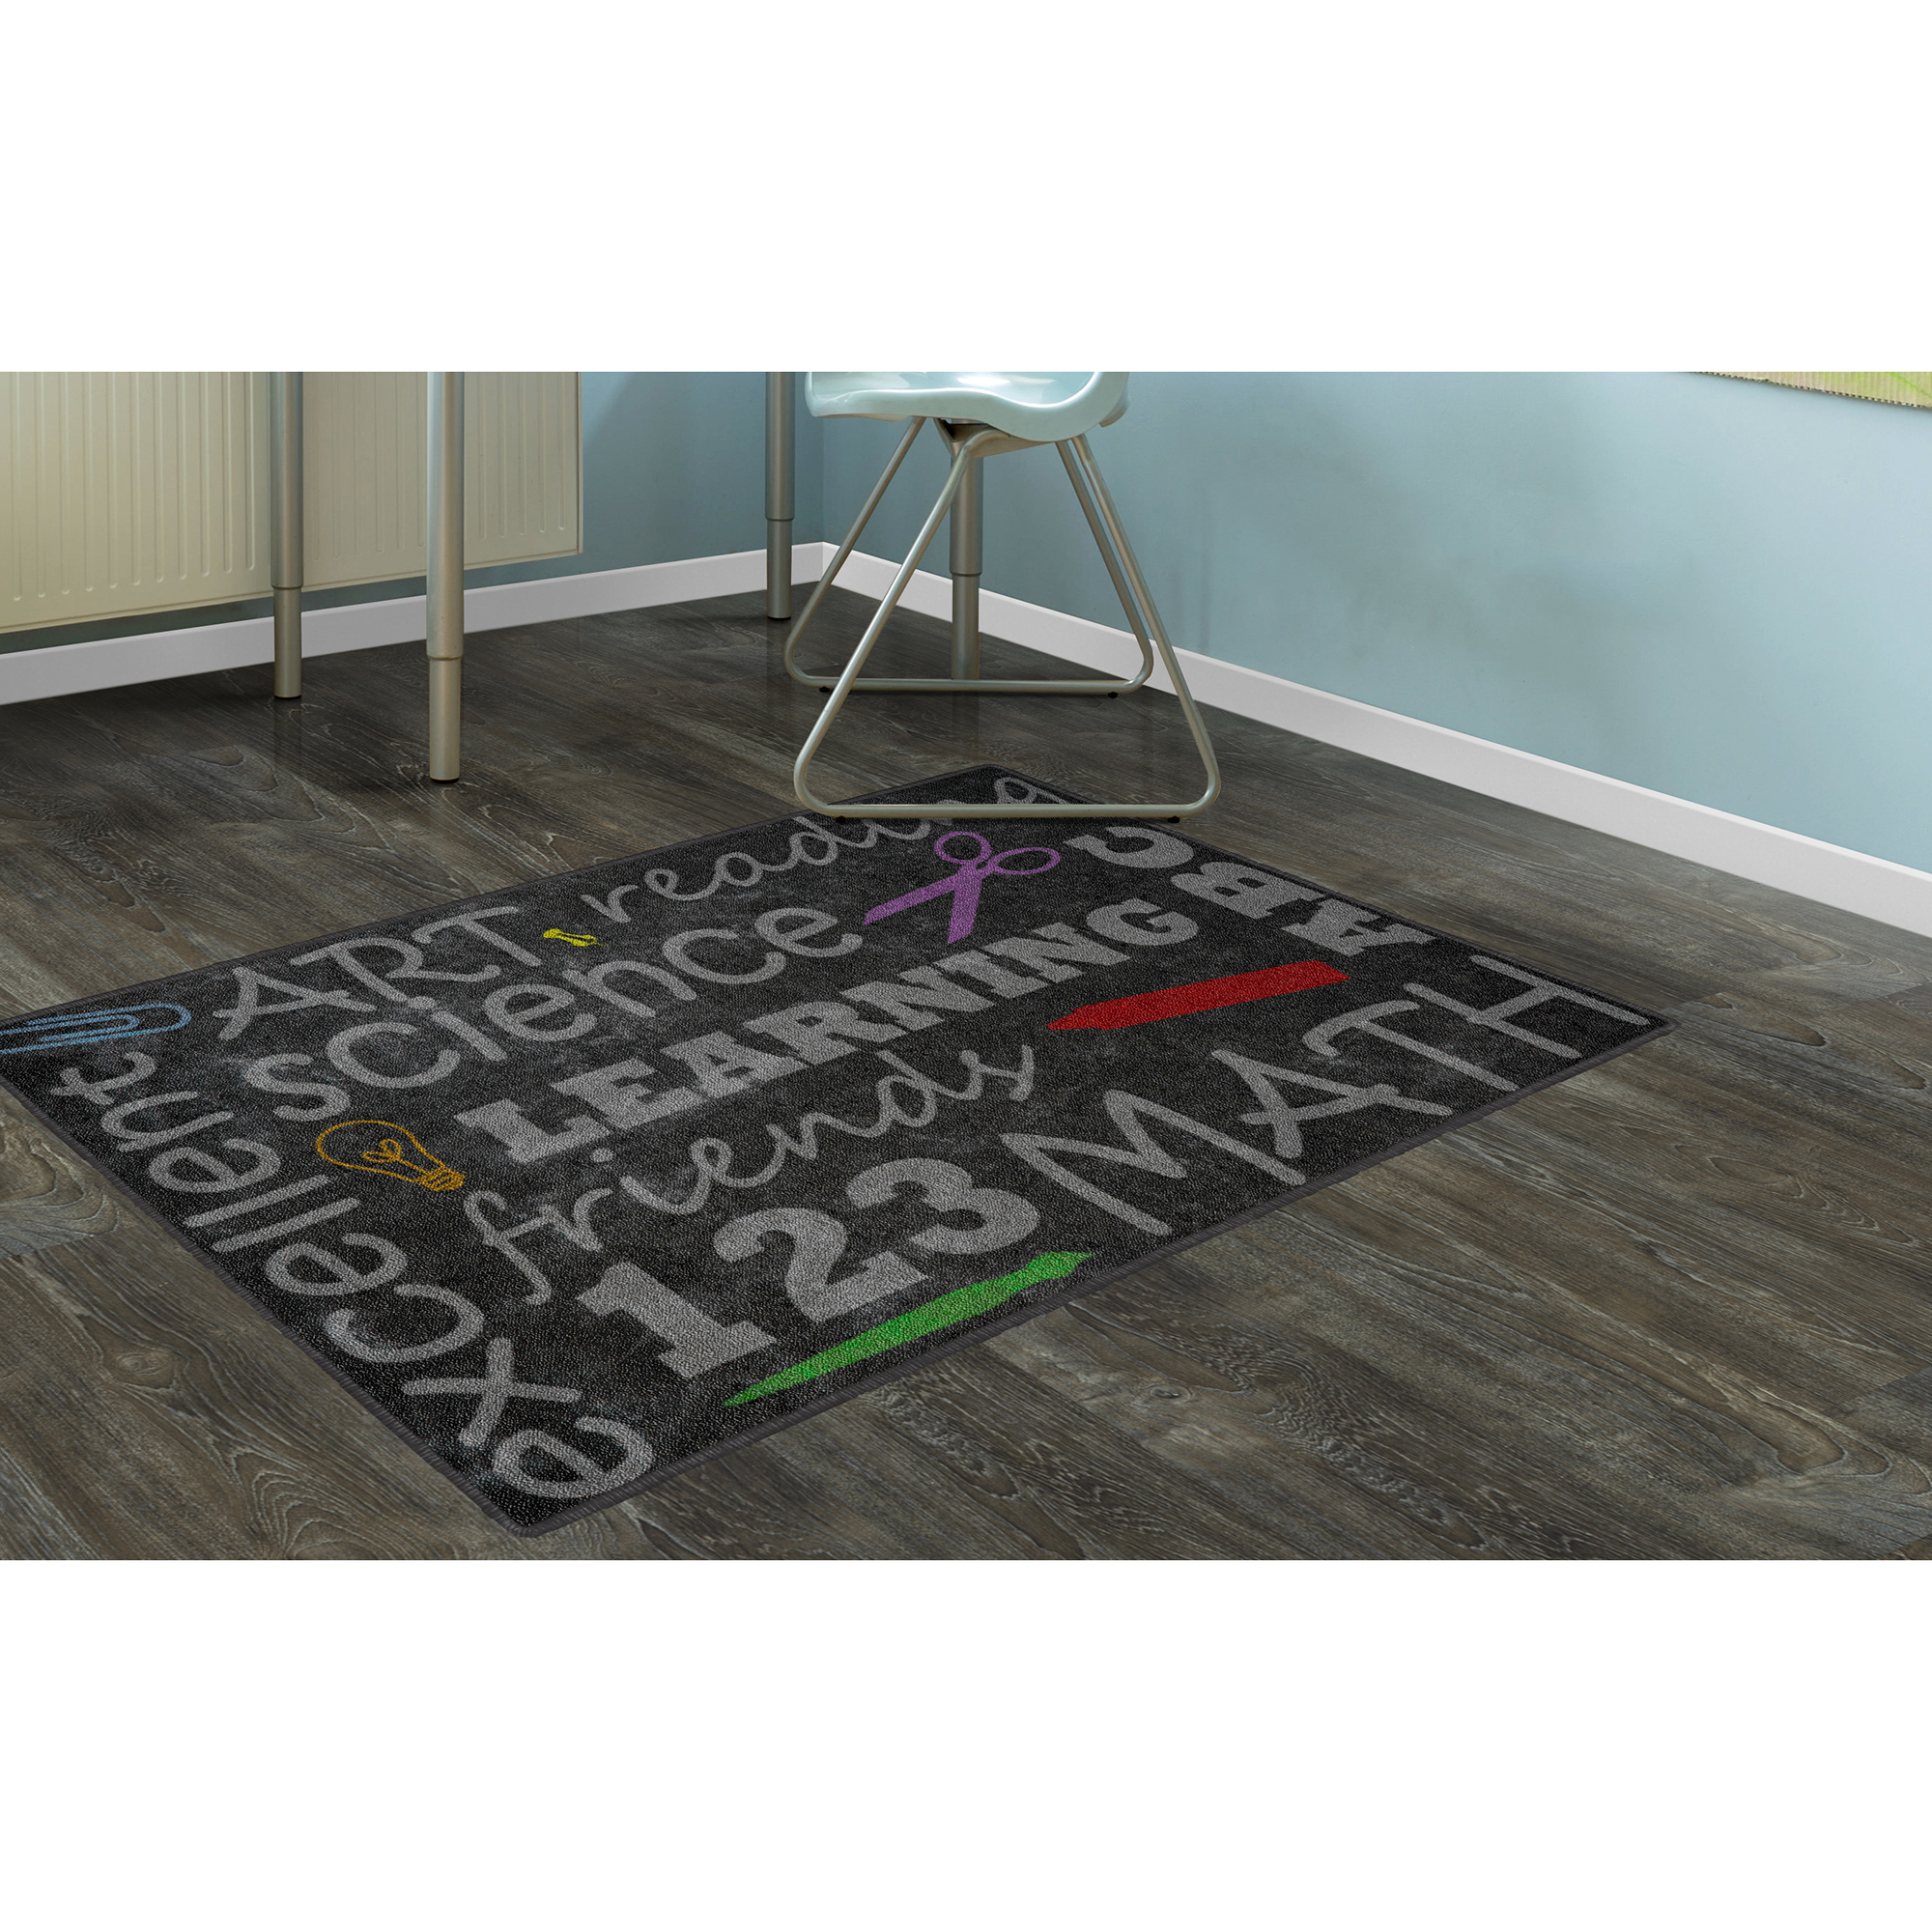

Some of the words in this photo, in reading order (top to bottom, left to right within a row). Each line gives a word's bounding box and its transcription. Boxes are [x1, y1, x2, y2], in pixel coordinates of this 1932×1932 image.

[213, 905, 546, 1040] ART
[1065, 826, 1435, 956] ABC
[456, 898, 1199, 1166] LEARNING
[1001, 954, 1650, 1236] MATH
[464, 1043, 1036, 1306] friends
[576, 1157, 1041, 1381] 123
